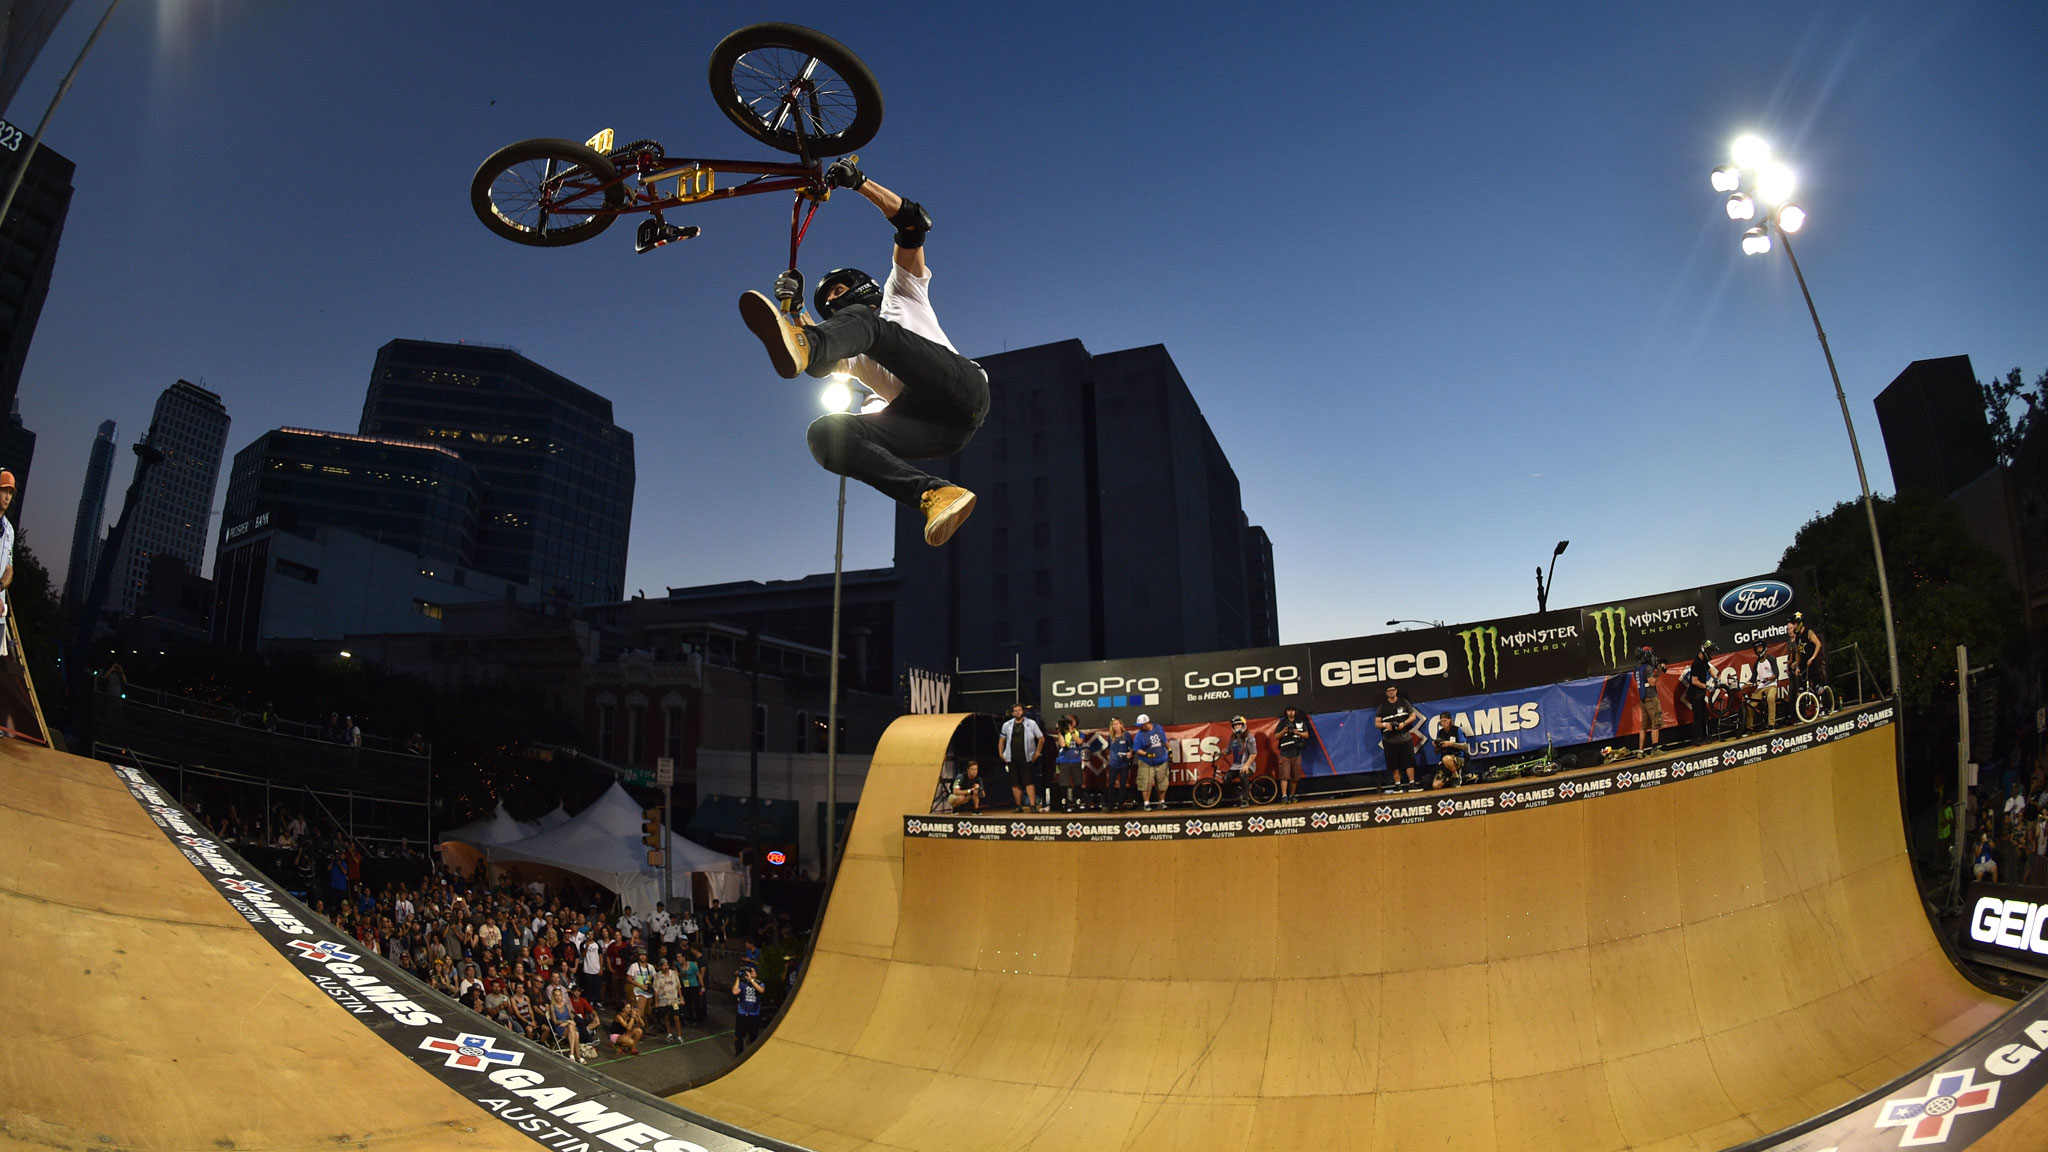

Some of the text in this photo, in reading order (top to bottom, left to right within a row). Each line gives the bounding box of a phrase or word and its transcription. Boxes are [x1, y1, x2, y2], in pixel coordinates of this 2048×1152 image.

[1735, 586, 1780, 615] Ford
[1629, 605, 1699, 628] MONSTER
[1641, 621, 1690, 635] ENERGY
[1734, 625, 1788, 644] Go Further
[1500, 625, 1579, 648] MONSTER
[1513, 641, 1568, 656] ENERGY
[1320, 649, 1448, 688] GEICO
[1184, 665, 1299, 689] GoPro
[1052, 676, 1160, 697] GoPro
[910, 676, 951, 715] NAVY
[1187, 693, 1197, 701] Be
[1204, 690, 1231, 700] HERO.
[1054, 701, 1063, 709] Be
[1070, 699, 1096, 708] HERO.
[1869, 708, 1894, 723] GAMES
[1828, 720, 1855, 736] GAMES
[1466, 736, 1518, 757] USTIN
[1784, 732, 1813, 748] GAMES
[1736, 744, 1768, 760] GAMES
[1686, 756, 1719, 772] GAMES
[1744, 756, 1762, 765] AUSTIN
[1632, 768, 1667, 783] GAMES
[1694, 768, 1713, 777] AUSTIN
[1575, 778, 1612, 793] GAMES
[1640, 780, 1660, 788] AUSTIN
[1516, 788, 1555, 803] GAMES
[1583, 790, 1605, 799] AUSTIN
[1392, 805, 1432, 818] GAMES
[1454, 797, 1494, 811] GAMES
[1525, 800, 1548, 809] AUSTIN
[1328, 812, 1369, 825] GAMES
[1464, 809, 1487, 817] AUSTIN
[921, 823, 954, 832] GAMES
[972, 824, 1007, 834] GAMES
[1026, 825, 1062, 835] GAMES
[1082, 825, 1120, 835] GAMES
[1141, 823, 1180, 834] GAMES
[1202, 821, 1243, 832] GAMES
[1264, 816, 1306, 829] GAMES
[767, 852, 786, 864] OPEN
[227, 897, 266, 924] AUSTIN
[243, 892, 313, 935] GAMES
[309, 974, 374, 1014] AUSTIN
[325, 962, 443, 1026] GAMES
